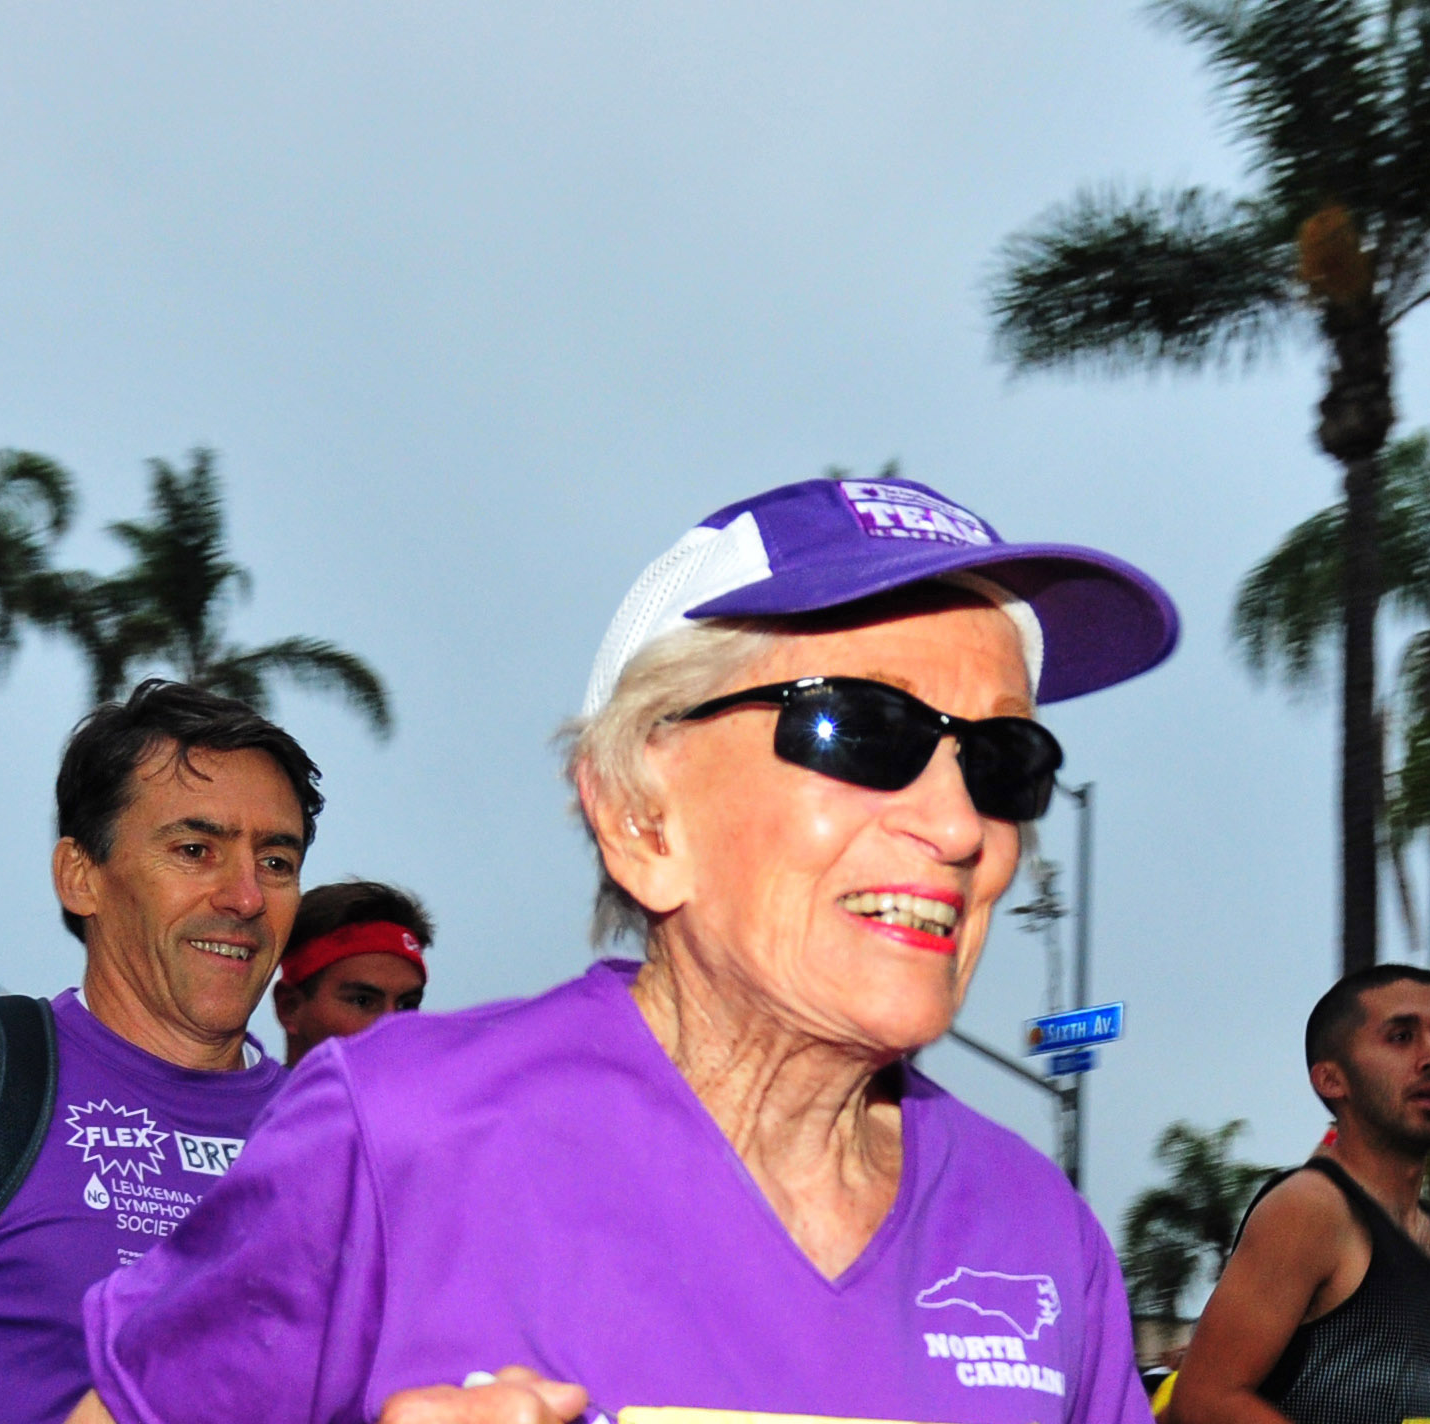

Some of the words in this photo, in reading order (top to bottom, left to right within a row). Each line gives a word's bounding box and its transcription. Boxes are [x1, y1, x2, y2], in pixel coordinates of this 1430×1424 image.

[1048, 1021, 1086, 1041] SIXTH
[85, 1126, 153, 1148] FLEX
[87, 1190, 107, 1205] NC
[112, 1178, 197, 1206] LEUKEMIA
[113, 1196, 190, 1219] LYMPHO
[923, 1333, 1027, 1361] NORTH
